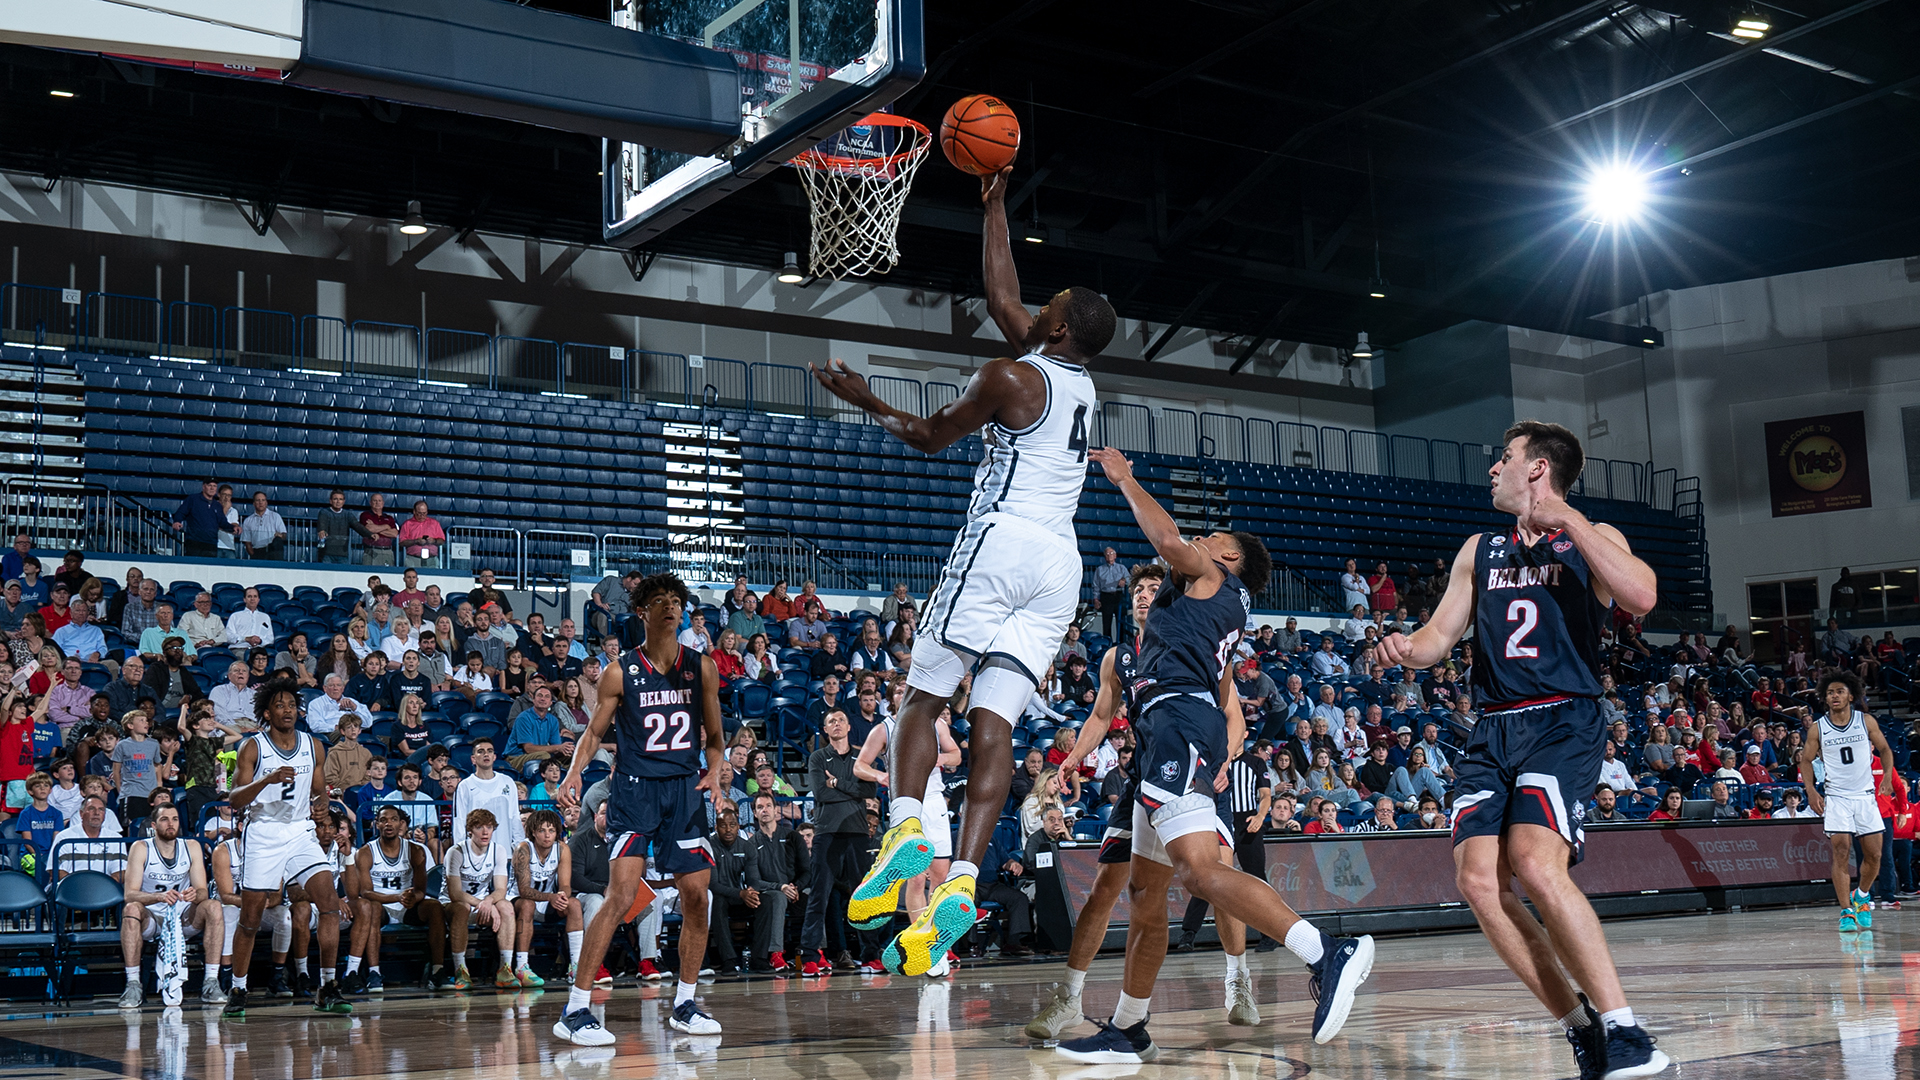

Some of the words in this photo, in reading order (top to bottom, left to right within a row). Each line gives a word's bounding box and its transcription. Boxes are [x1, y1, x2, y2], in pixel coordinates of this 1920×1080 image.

[766, 60, 819, 77] SAMORD
[850, 138, 874, 149] NCAA
[66, 294, 79, 302] CC
[1067, 403, 1089, 464] 4
[1778, 424, 1815, 456] WELCOME
[1818, 424, 1832, 433] TO
[1487, 563, 1563, 591] BELMONT
[1504, 598, 1540, 659] 2
[639, 689, 692, 708] BELMONT
[643, 710, 692, 752] 22
[1824, 733, 1866, 747] SAMFORD
[1840, 746, 1854, 765] 0
[282, 777, 296, 801] 2
[1697, 839, 1760, 854] TOGETHER
[1782, 839, 1831, 865] Coca-Cola
[1691, 859, 1736, 873] TASTES
[1739, 857, 1781, 872] BETTER
[381, 876, 402, 890] 14
[465, 882, 481, 895] 3
